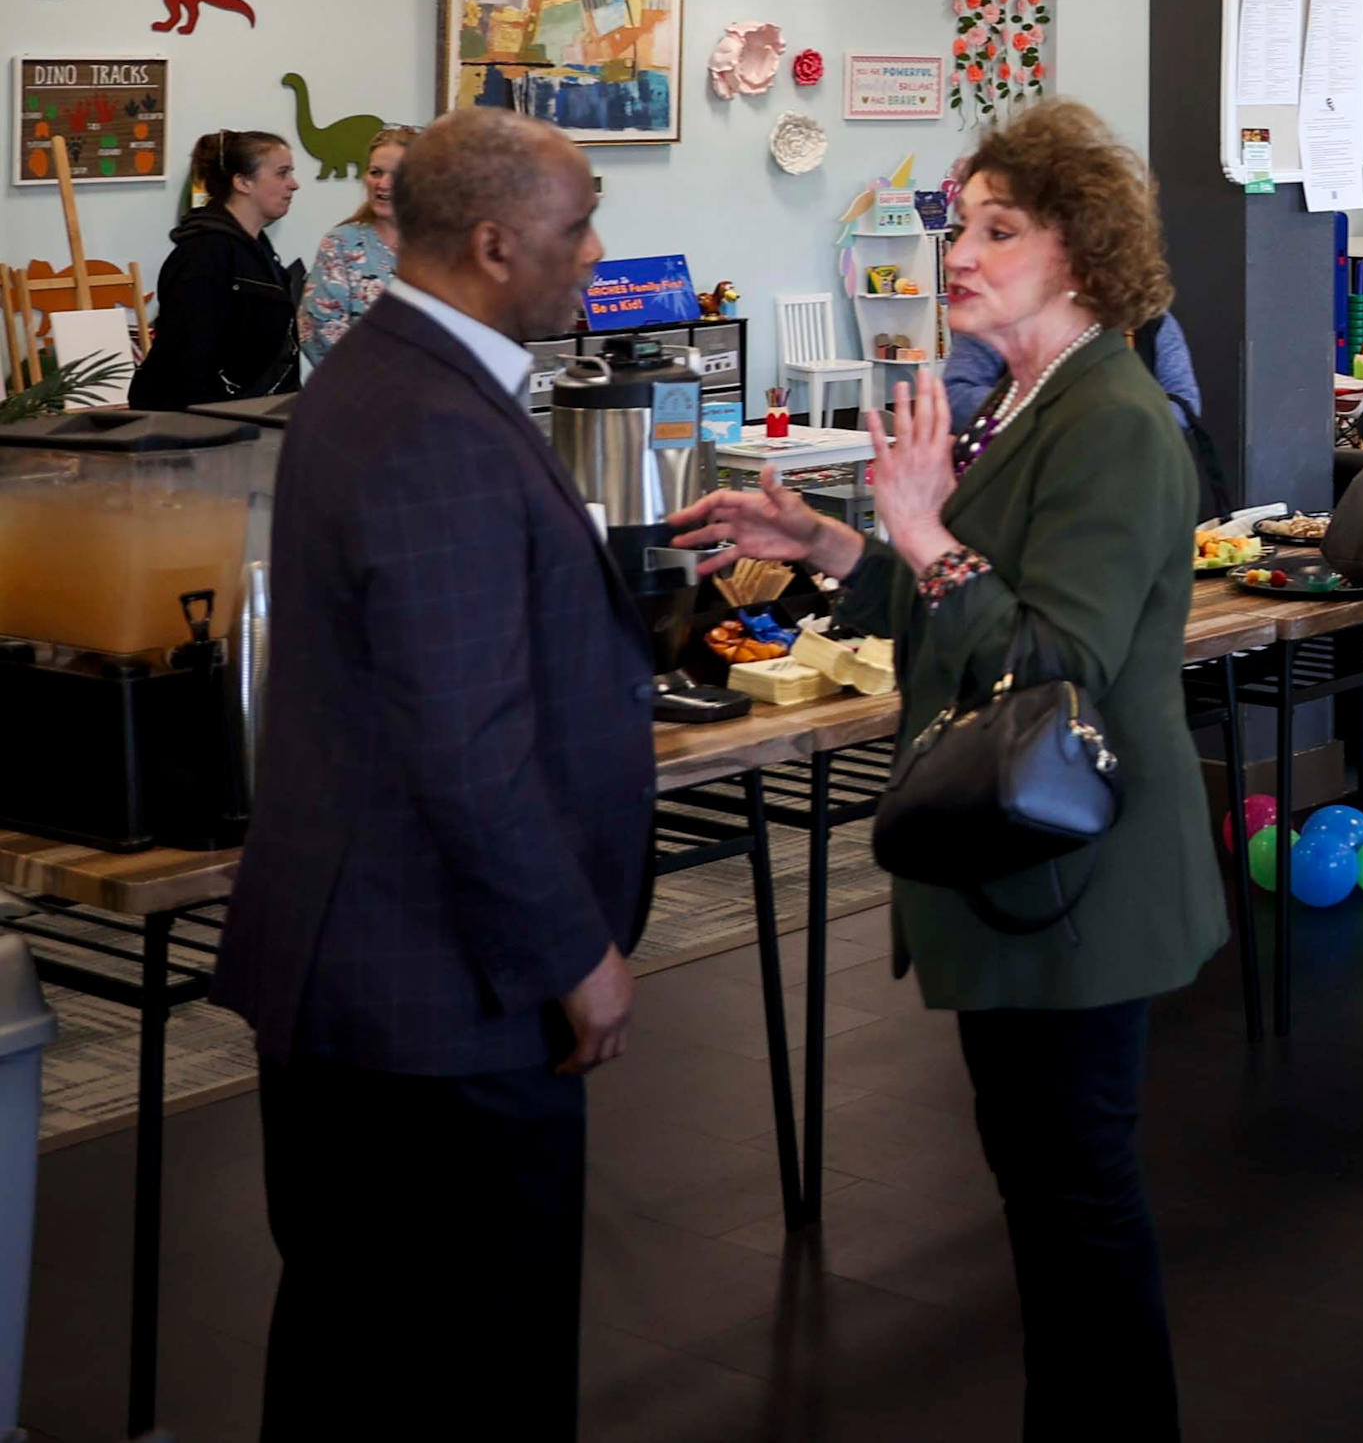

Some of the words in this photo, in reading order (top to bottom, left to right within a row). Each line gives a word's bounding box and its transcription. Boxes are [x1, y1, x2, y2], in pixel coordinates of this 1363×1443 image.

[35, 65, 77, 85] DINO
[90, 65, 150, 85] TRACKS
[587, 284, 628, 297] ARCHES
[628, 281, 662, 293] Family
[661, 279, 685, 289] First
[591, 303, 608, 314] Be
[610, 303, 619, 312] a
[620, 298, 644, 311] Kid!
